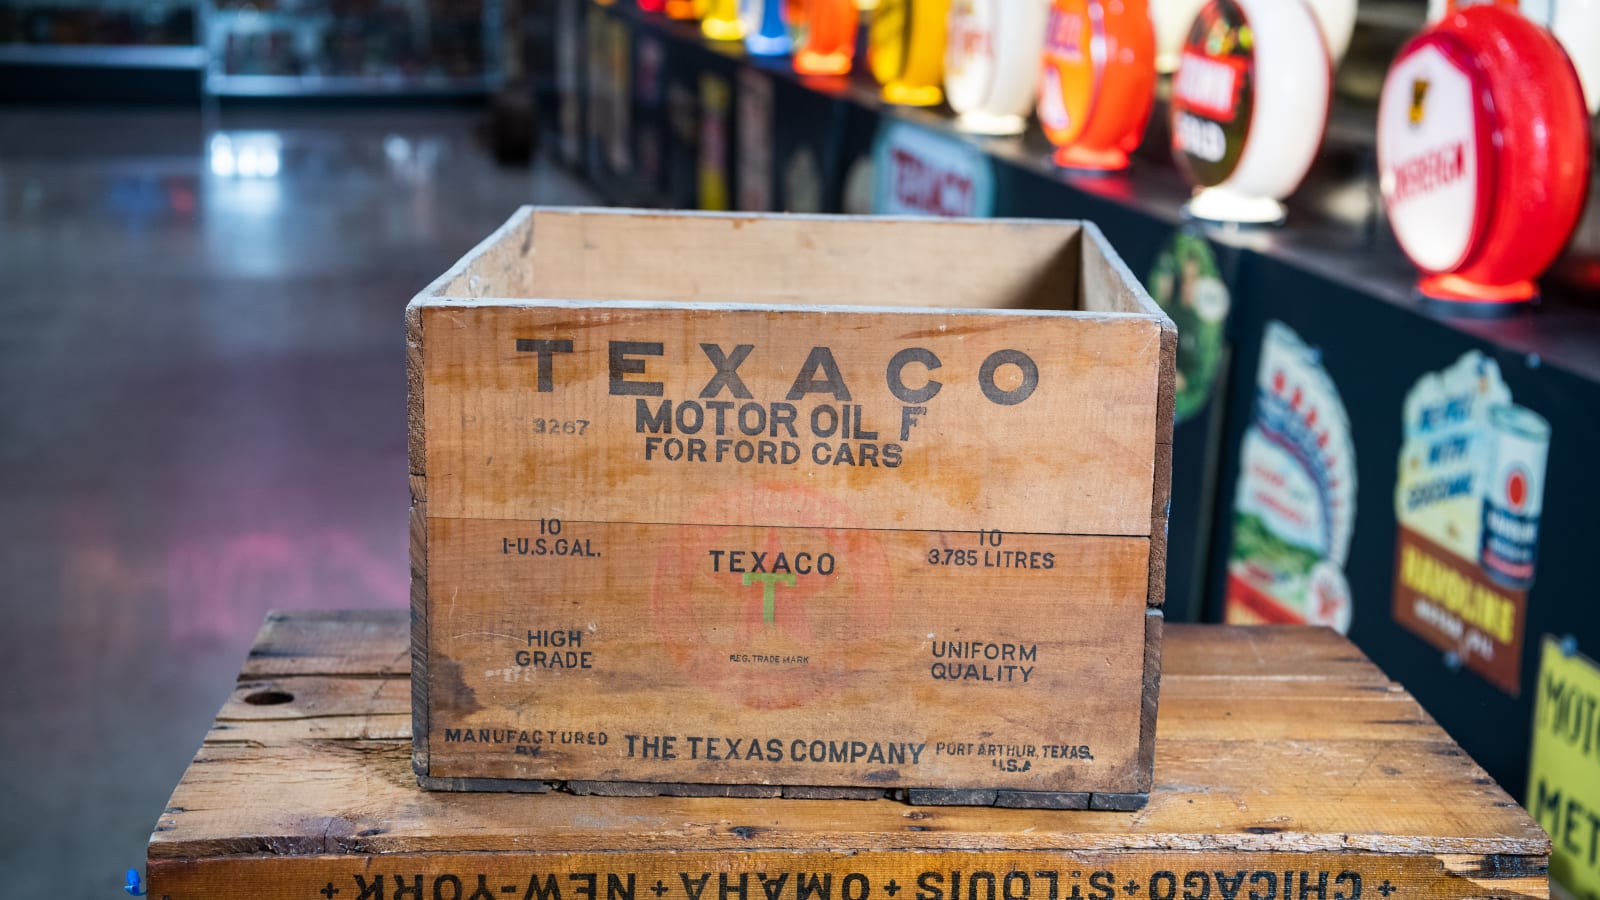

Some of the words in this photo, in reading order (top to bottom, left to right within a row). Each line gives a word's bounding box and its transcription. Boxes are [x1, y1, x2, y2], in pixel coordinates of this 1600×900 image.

[515, 337, 1040, 406] TEXACO
[635, 398, 798, 439] MOTOR
[810, 403, 878, 440] OIL
[900, 406, 927, 441] F
[645, 437, 707, 462] FOR
[716, 439, 801, 465] FORD
[811, 441, 903, 468] CARS
[540, 518, 562, 535] 10
[979, 528, 1003, 547] 10
[708, 550, 836, 576] TEXACO
[928, 548, 978, 567] 3.785
[984, 550, 1055, 570] LITRES
[526, 629, 582, 648] HIGH
[515, 650, 593, 669] GRADE
[729, 654, 751, 663] REG.
[752, 654, 781, 664] TRADE
[782, 655, 809, 664] MARK
[931, 640, 1038, 662] UNIFORM
[930, 662, 1034, 683] QUALITY
[444, 728, 609, 746] MANUFACTURED
[625, 734, 677, 760] THE
[686, 736, 784, 763] TEXAS
[790, 738, 926, 765] COMPANY
[935, 741, 974, 756] PORT
[679, 871, 870, 900] OMAHA
[1149, 869, 1362, 900] CHICAGO
